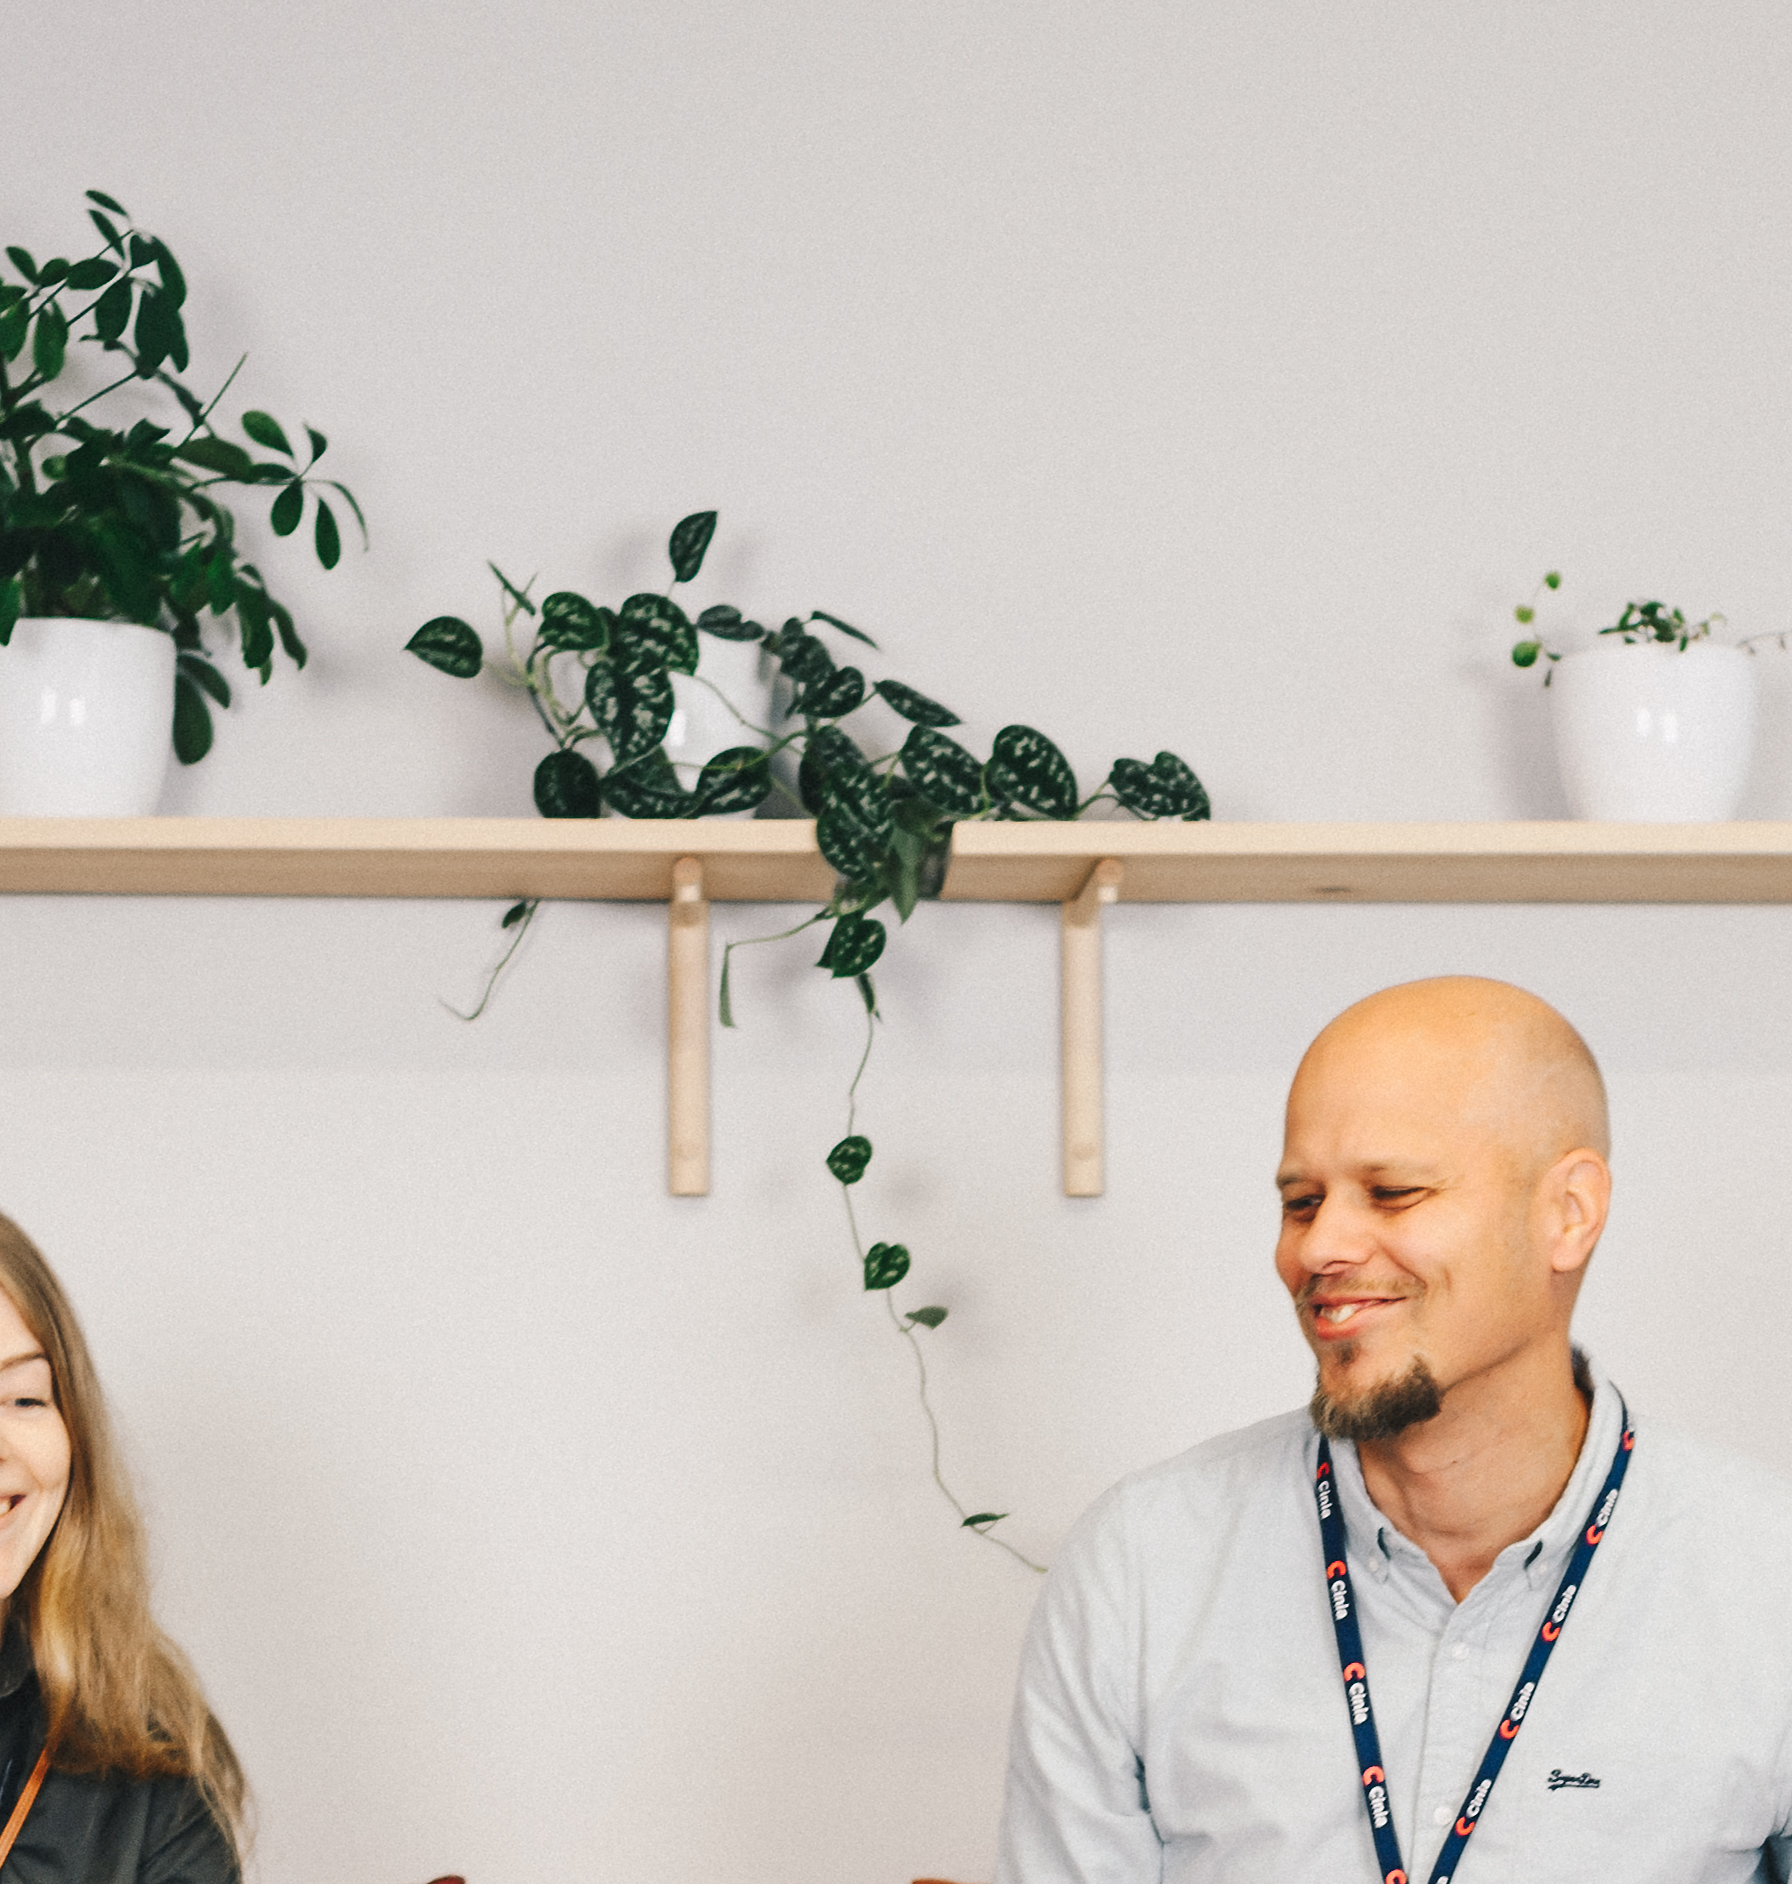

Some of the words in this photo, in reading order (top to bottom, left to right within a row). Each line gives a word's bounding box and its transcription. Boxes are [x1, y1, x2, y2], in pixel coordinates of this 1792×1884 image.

[1596, 1488, 1619, 1527] Cinia
[1331, 1580, 1349, 1621] Cinia
[1552, 1584, 1577, 1623] Cinia
[1348, 1682, 1369, 1725] Cinia
[1510, 1681, 1536, 1721] Cinia
[1368, 1786, 1388, 1829] Cinia
[1465, 1778, 1493, 1818] Cinia
